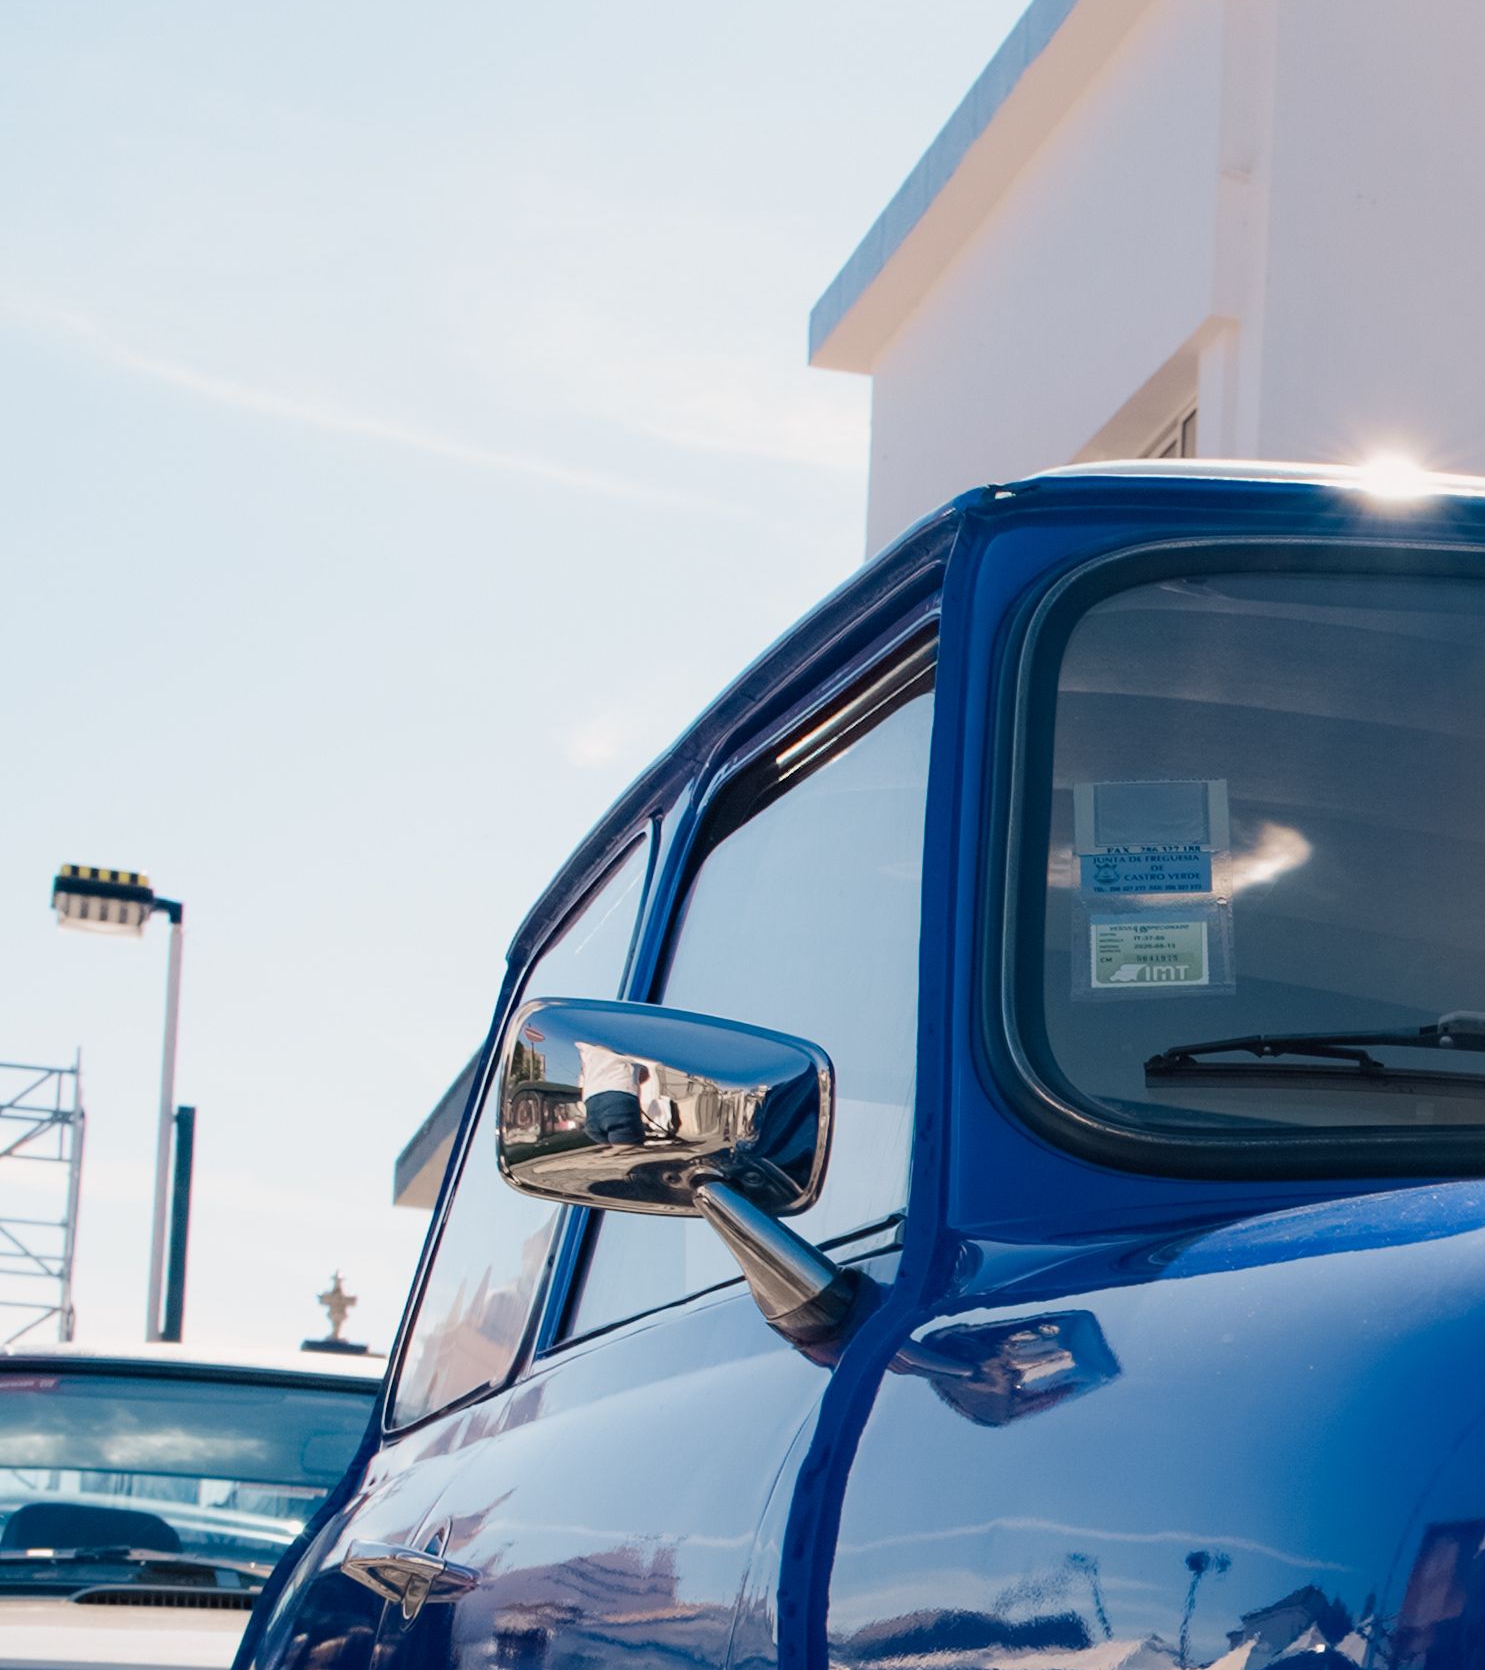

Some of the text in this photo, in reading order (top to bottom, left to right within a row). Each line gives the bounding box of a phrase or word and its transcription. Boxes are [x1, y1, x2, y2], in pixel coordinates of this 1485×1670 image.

[1093, 856, 1125, 864] JUNTA
[1150, 864, 1164, 872] DE
[1124, 872, 1200, 881] CASTRO VERDE
[1146, 965, 1190, 982] IMT
